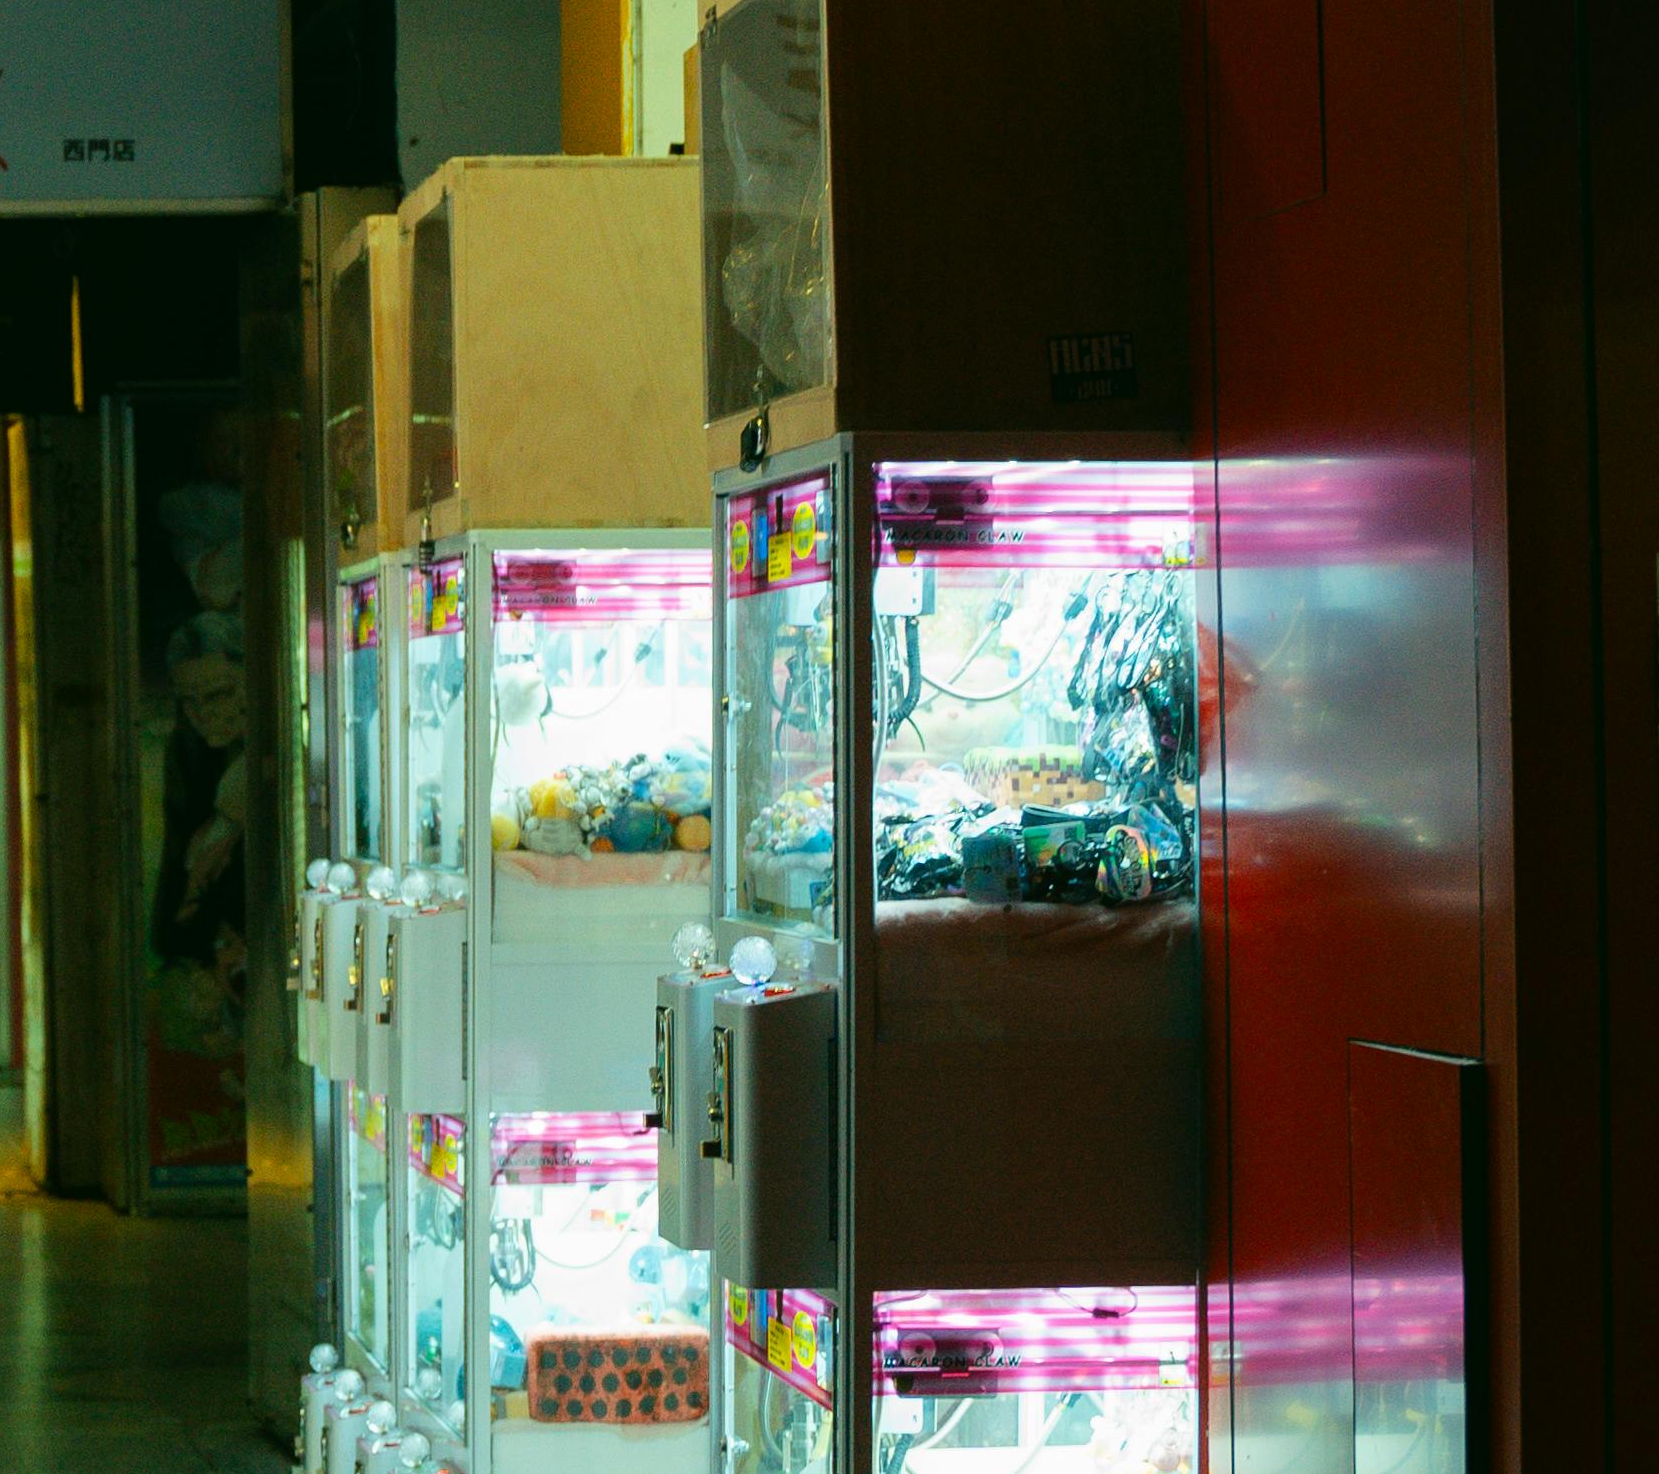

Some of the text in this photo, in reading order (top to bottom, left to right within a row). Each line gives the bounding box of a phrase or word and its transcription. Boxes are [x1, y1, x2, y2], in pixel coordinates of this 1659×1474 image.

[63, 139, 136, 164] 西門店
[884, 529, 1025, 543] MACARON CLAW
[883, 1354, 1022, 1369] MACARON CLAW
